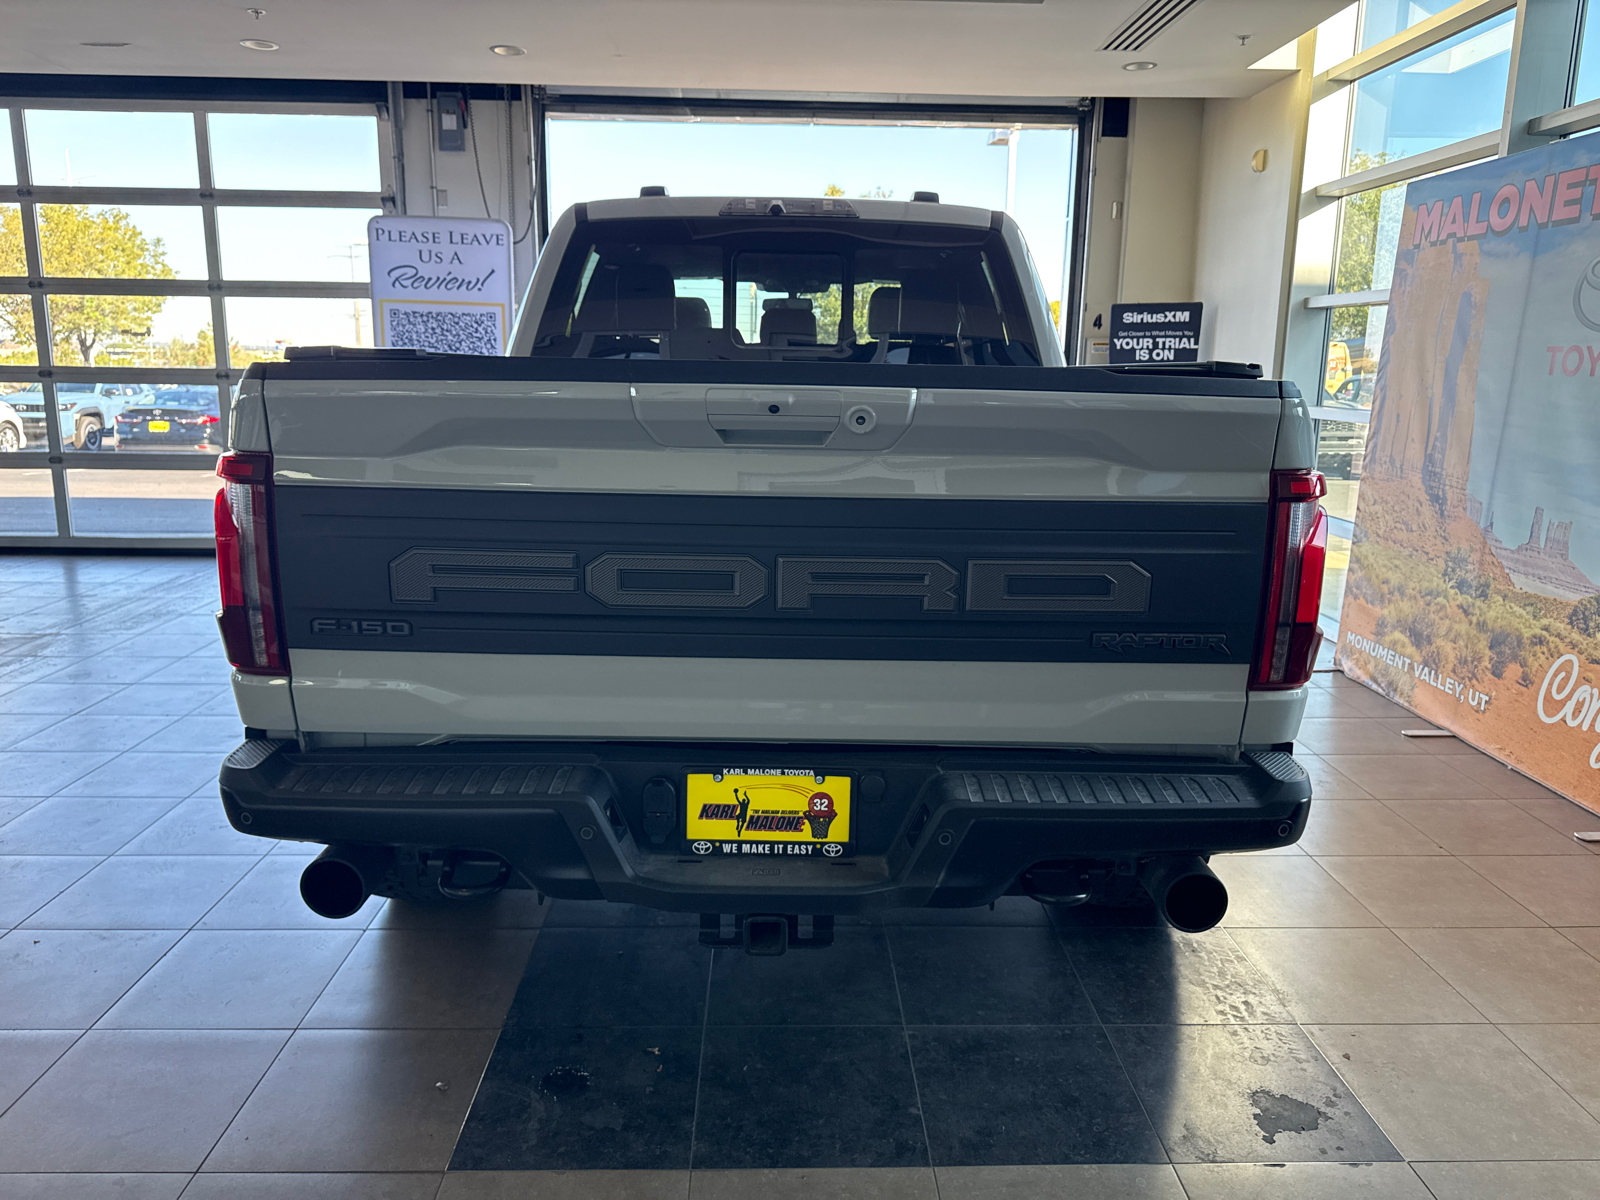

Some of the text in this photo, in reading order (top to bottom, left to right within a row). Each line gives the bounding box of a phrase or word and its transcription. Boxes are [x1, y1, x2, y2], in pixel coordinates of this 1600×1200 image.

[374, 227, 505, 246] PLEASE LEAVE
[418, 249, 464, 265] US A
[387, 264, 496, 292] Review!
[1092, 313, 1103, 330] 4
[1122, 311, 1190, 323] SiriusXM
[1113, 338, 1153, 349] YOUR
[1155, 337, 1199, 349] TRIAL
[1135, 349, 1175, 360] IS ON
[388, 545, 1152, 616] FORD
[311, 617, 412, 636] F-150
[1091, 631, 1232, 657] RAPTOR
[1346, 630, 1490, 711] MONUMENT VALLEY, UT
[722, 768, 815, 777] KARL MALONE TOYOTA
[698, 803, 739, 820] KARL
[813, 798, 828, 811] 32
[745, 815, 805, 832] MALONE
[722, 843, 814, 855] WE MAKE IT EASY
